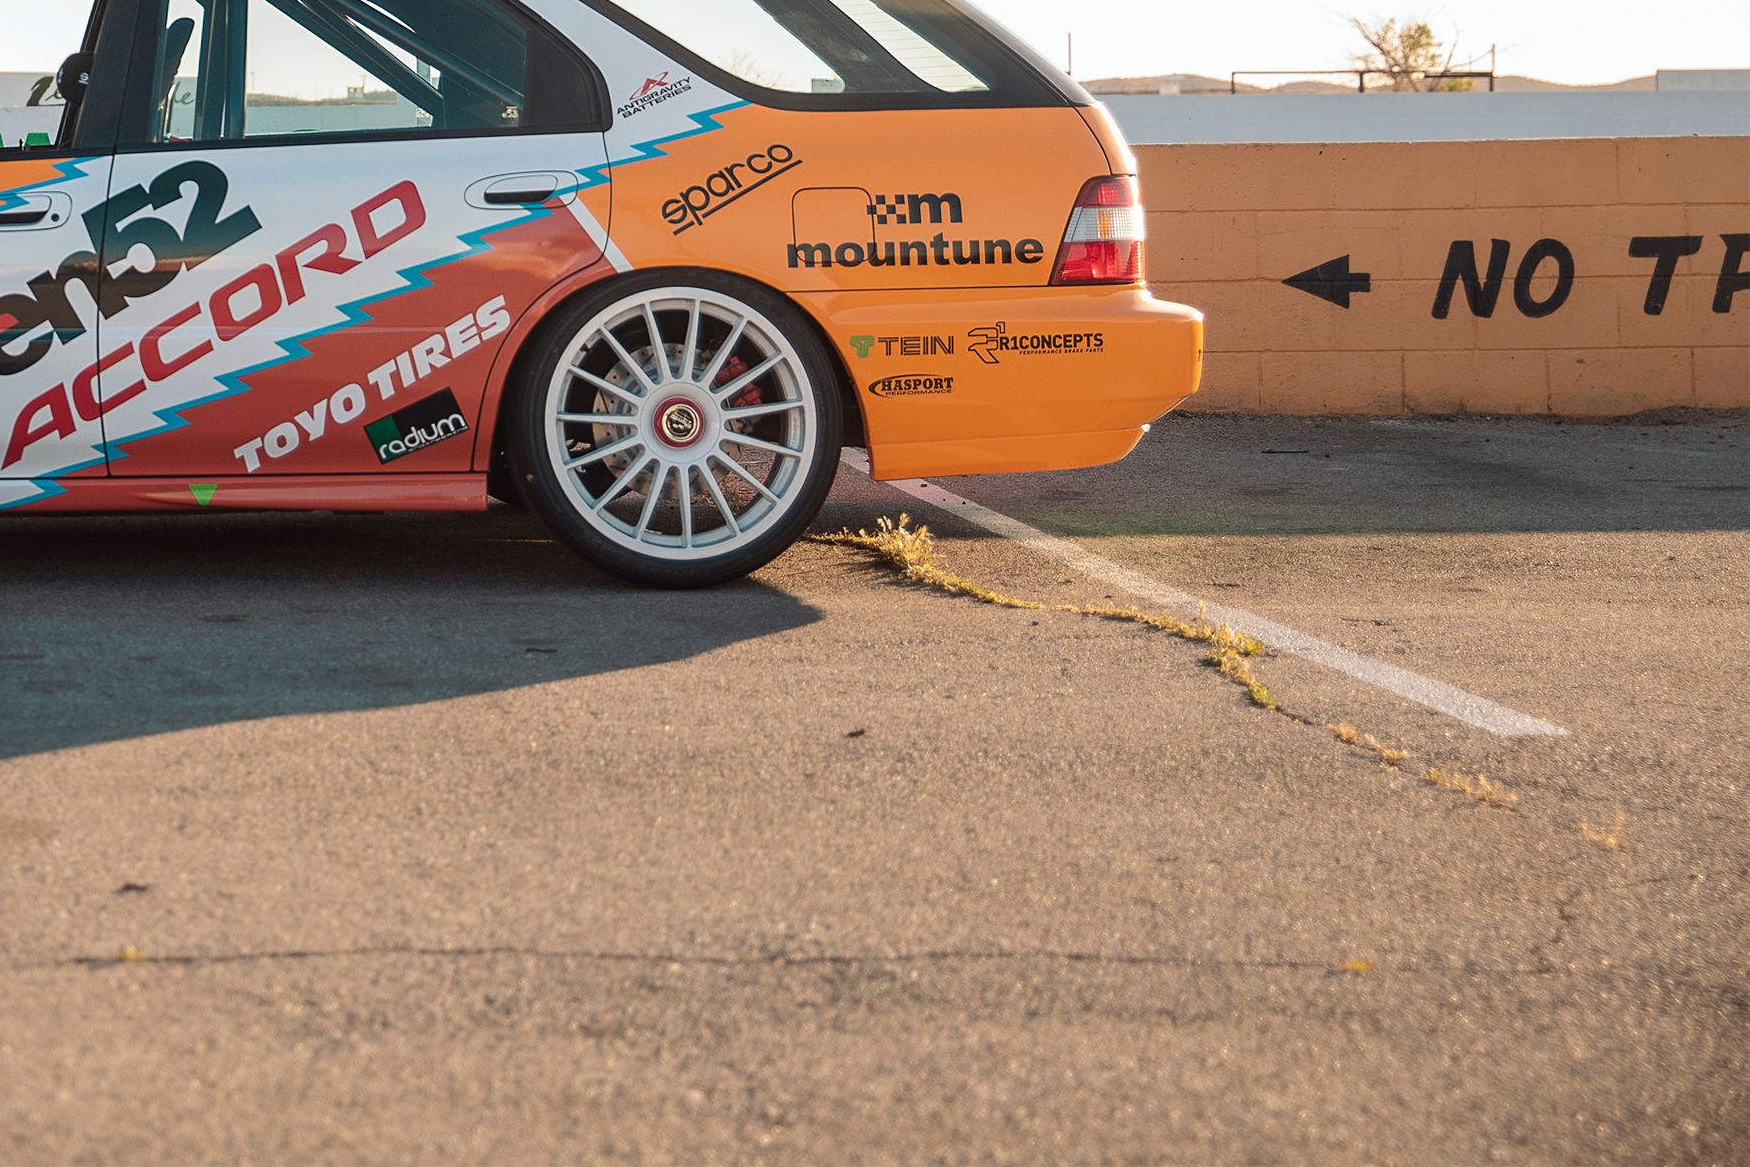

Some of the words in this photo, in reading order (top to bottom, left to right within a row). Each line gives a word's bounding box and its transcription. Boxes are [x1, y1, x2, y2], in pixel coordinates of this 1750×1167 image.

[617, 76, 690, 115] ANTIGRAVITY
[622, 84, 692, 118] BATTERIES
[661, 143, 794, 227] sparco
[787, 232, 1045, 268] mountune
[1431, 238, 1576, 320] NO
[0, 180, 427, 471] ACCORD
[878, 335, 955, 357] TEIN
[233, 382, 367, 474] TOYO
[367, 294, 512, 401] TIRES
[881, 377, 954, 392] HASPORT
[885, 388, 952, 396] PERFORMANCE
[379, 413, 466, 461] radium
